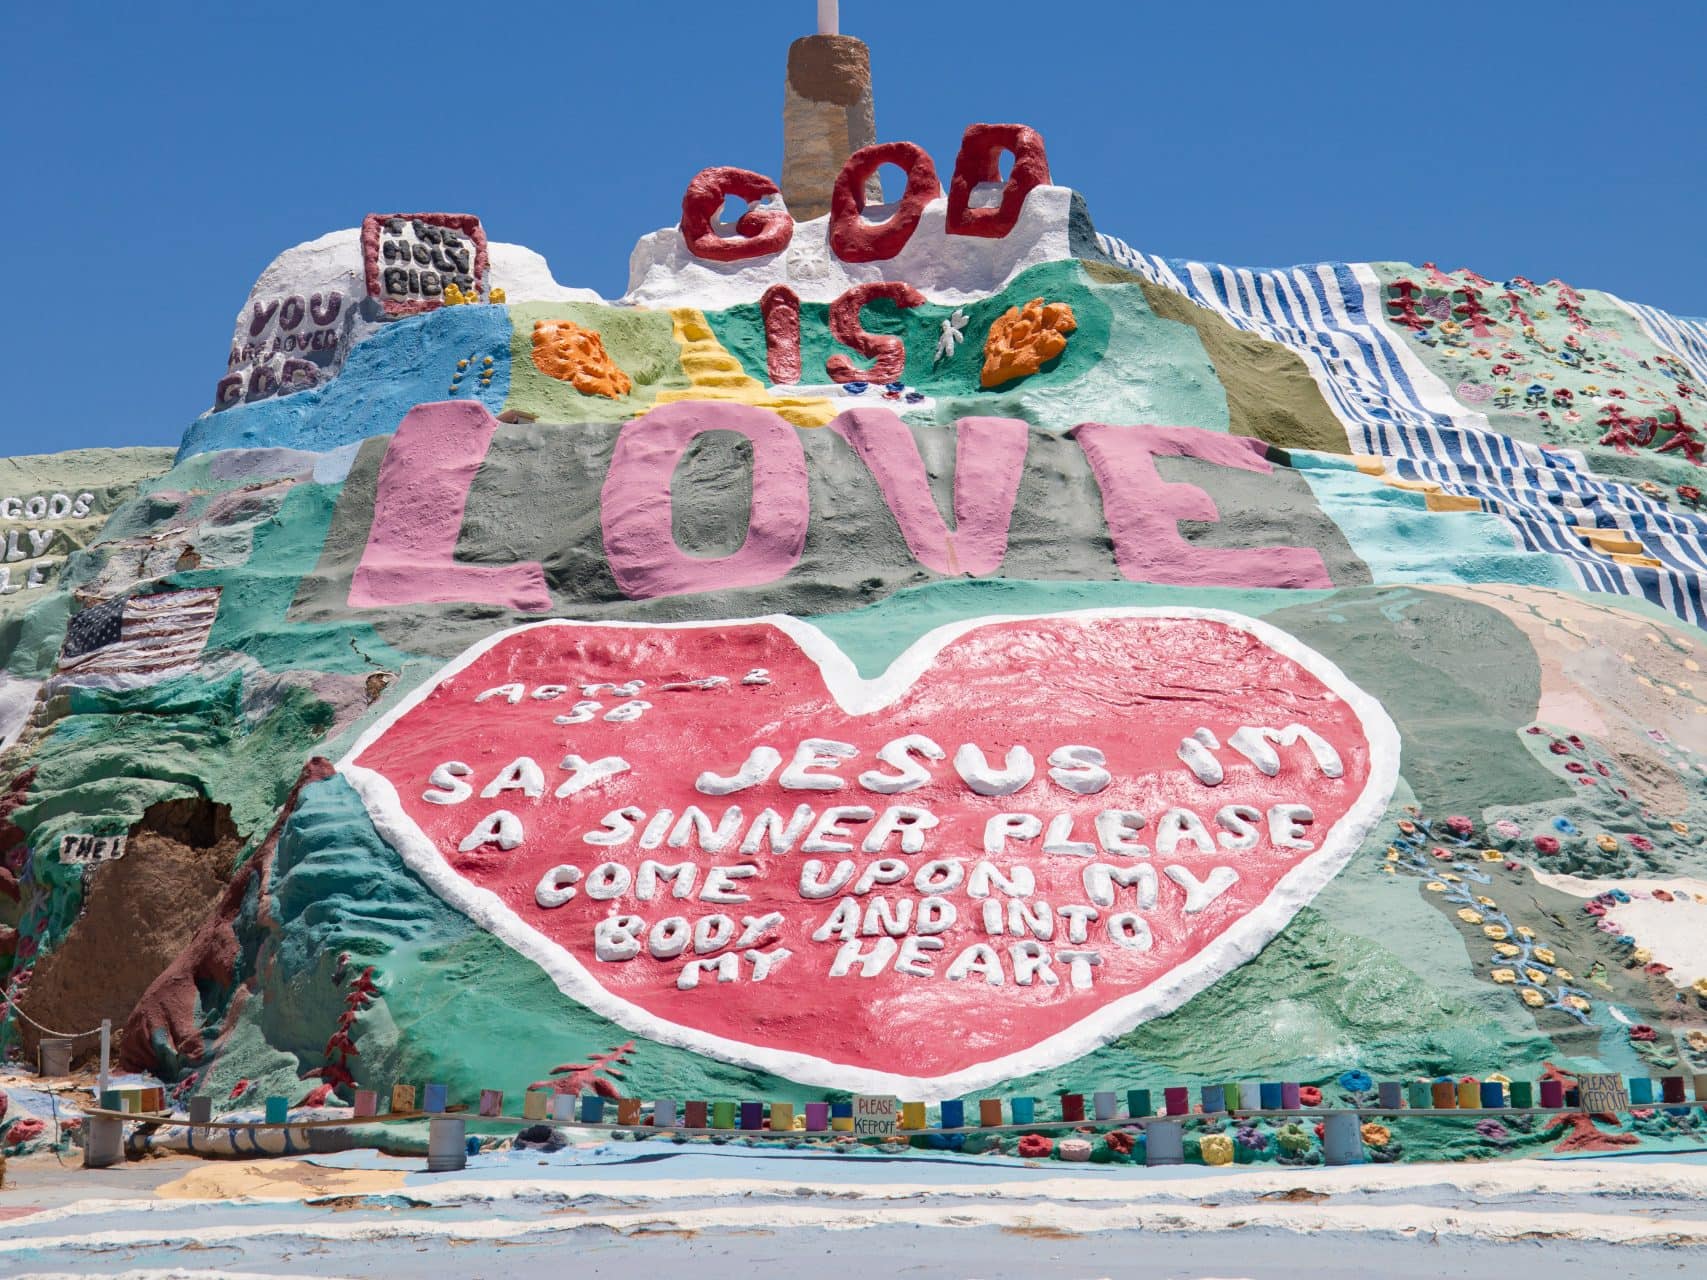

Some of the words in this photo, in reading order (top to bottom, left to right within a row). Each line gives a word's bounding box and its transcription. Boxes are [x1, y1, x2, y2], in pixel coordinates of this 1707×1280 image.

[681, 123, 1050, 263] GOD
[383, 239, 470, 274] HOLY
[250, 291, 342, 337] YOU
[760, 281, 927, 385] IS
[214, 358, 320, 410] GOD
[0, 492, 95, 520] GODS
[345, 400, 1334, 611] LOVE
[0, 528, 54, 562] LY
[422, 753, 632, 806] SAY
[695, 733, 1112, 797] JESUS
[64, 836, 107, 858] THE
[458, 808, 524, 853] A
[583, 802, 941, 856] SINNER
[983, 802, 1315, 858] PLEASE
[535, 859, 760, 908] COME
[800, 856, 1035, 899] UPON
[1082, 862, 1240, 915] MY
[594, 910, 785, 963] BODY
[812, 895, 957, 942] AND
[982, 898, 1152, 951] INTO
[677, 947, 793, 991] MY
[829, 935, 1102, 990] HEART
[858, 1097, 893, 1115] PLEASE
[1580, 1075, 1618, 1091] PLEASE
